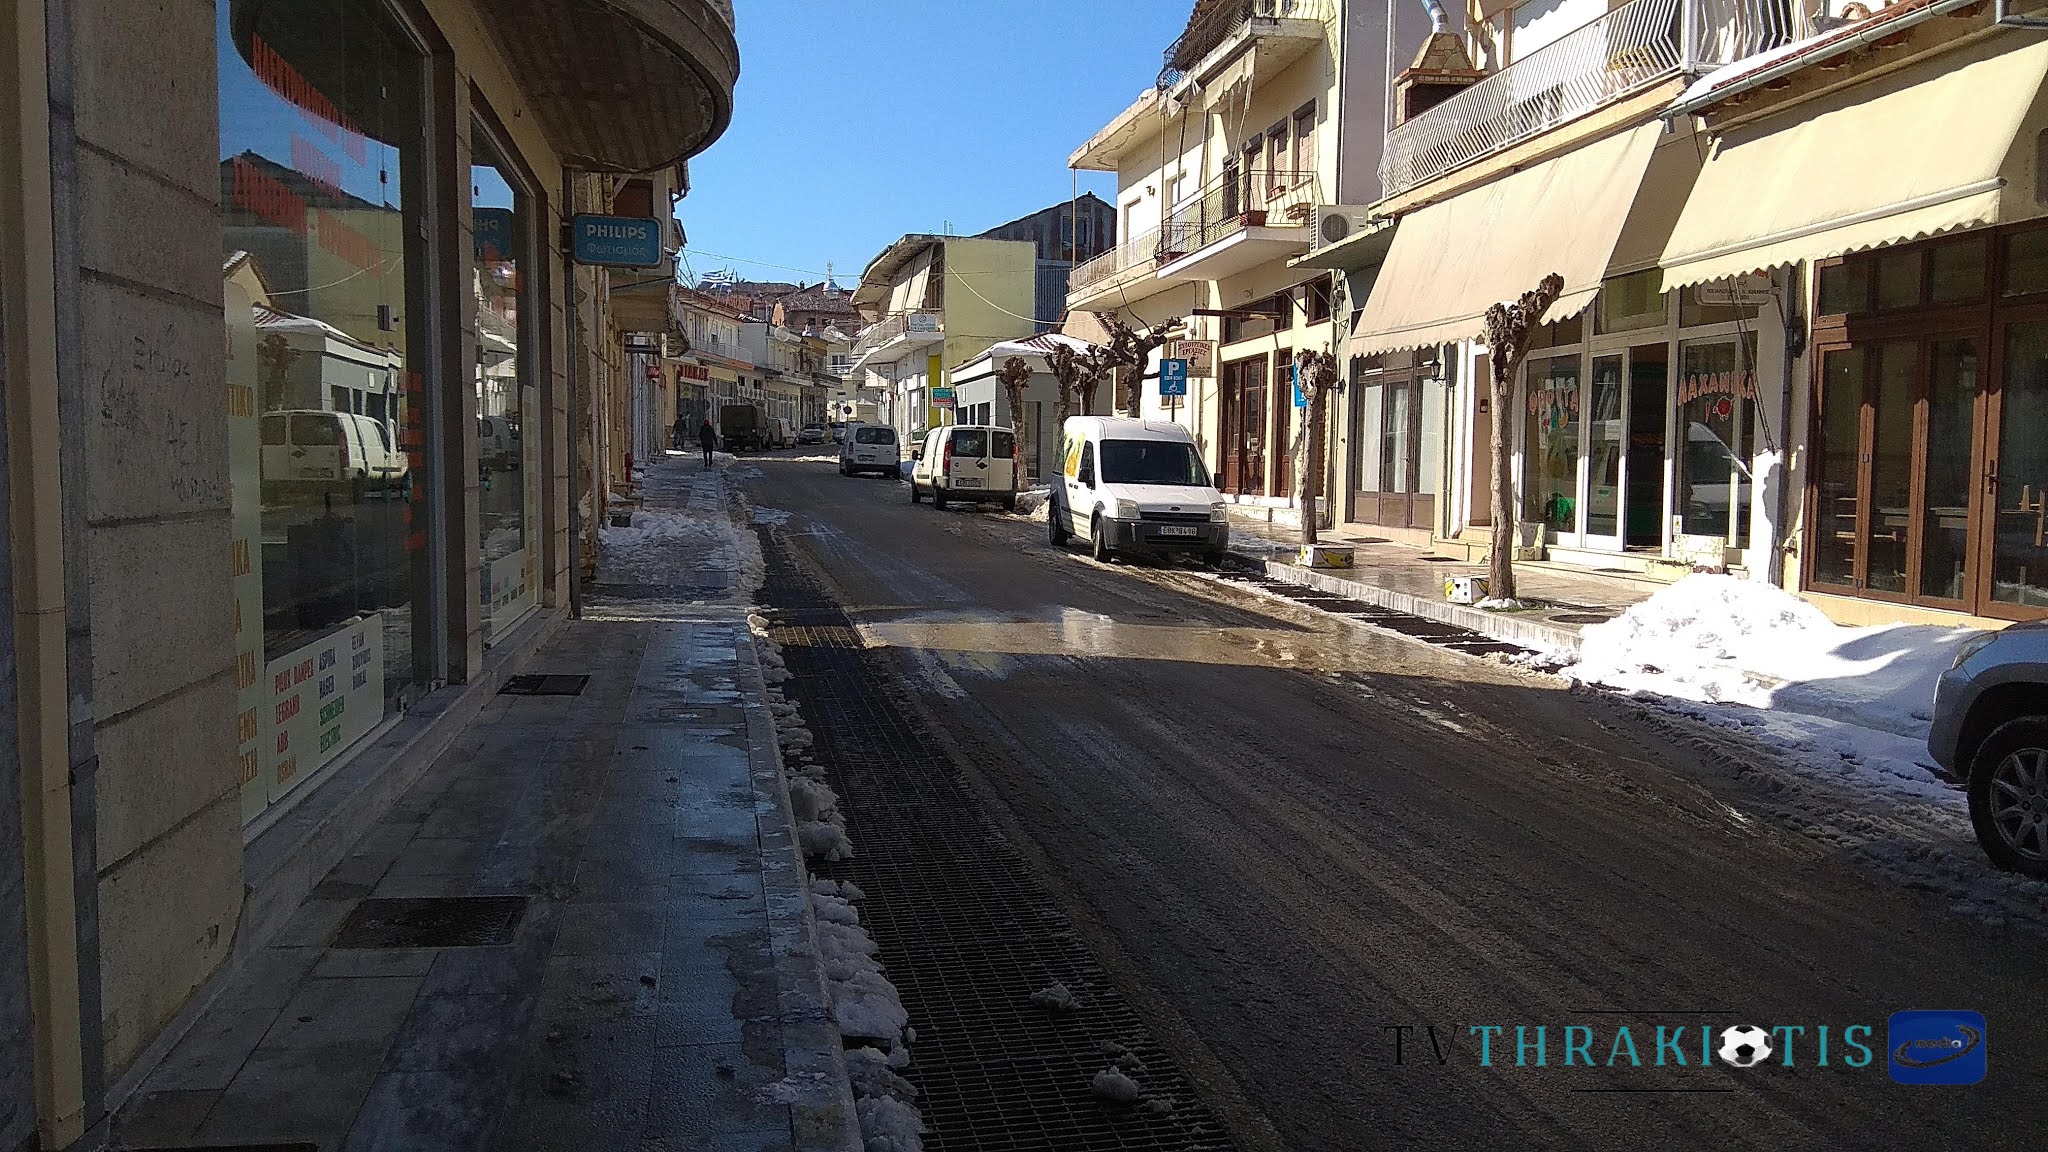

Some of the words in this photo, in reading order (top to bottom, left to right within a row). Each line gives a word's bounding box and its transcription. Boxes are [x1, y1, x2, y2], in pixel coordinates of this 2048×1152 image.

[586, 224, 647, 240] PHILIPS
[1168, 361, 1180, 376] P
[1677, 369, 1757, 407] ΛΑΧΑΝΙΚΑ
[275, 694, 300, 725] LEGRAND
[319, 695, 345, 727] SCHNEIDER
[277, 731, 289, 756] ABB
[319, 723, 342, 754] ELECTRIC
[277, 754, 297, 785] OSRAM
